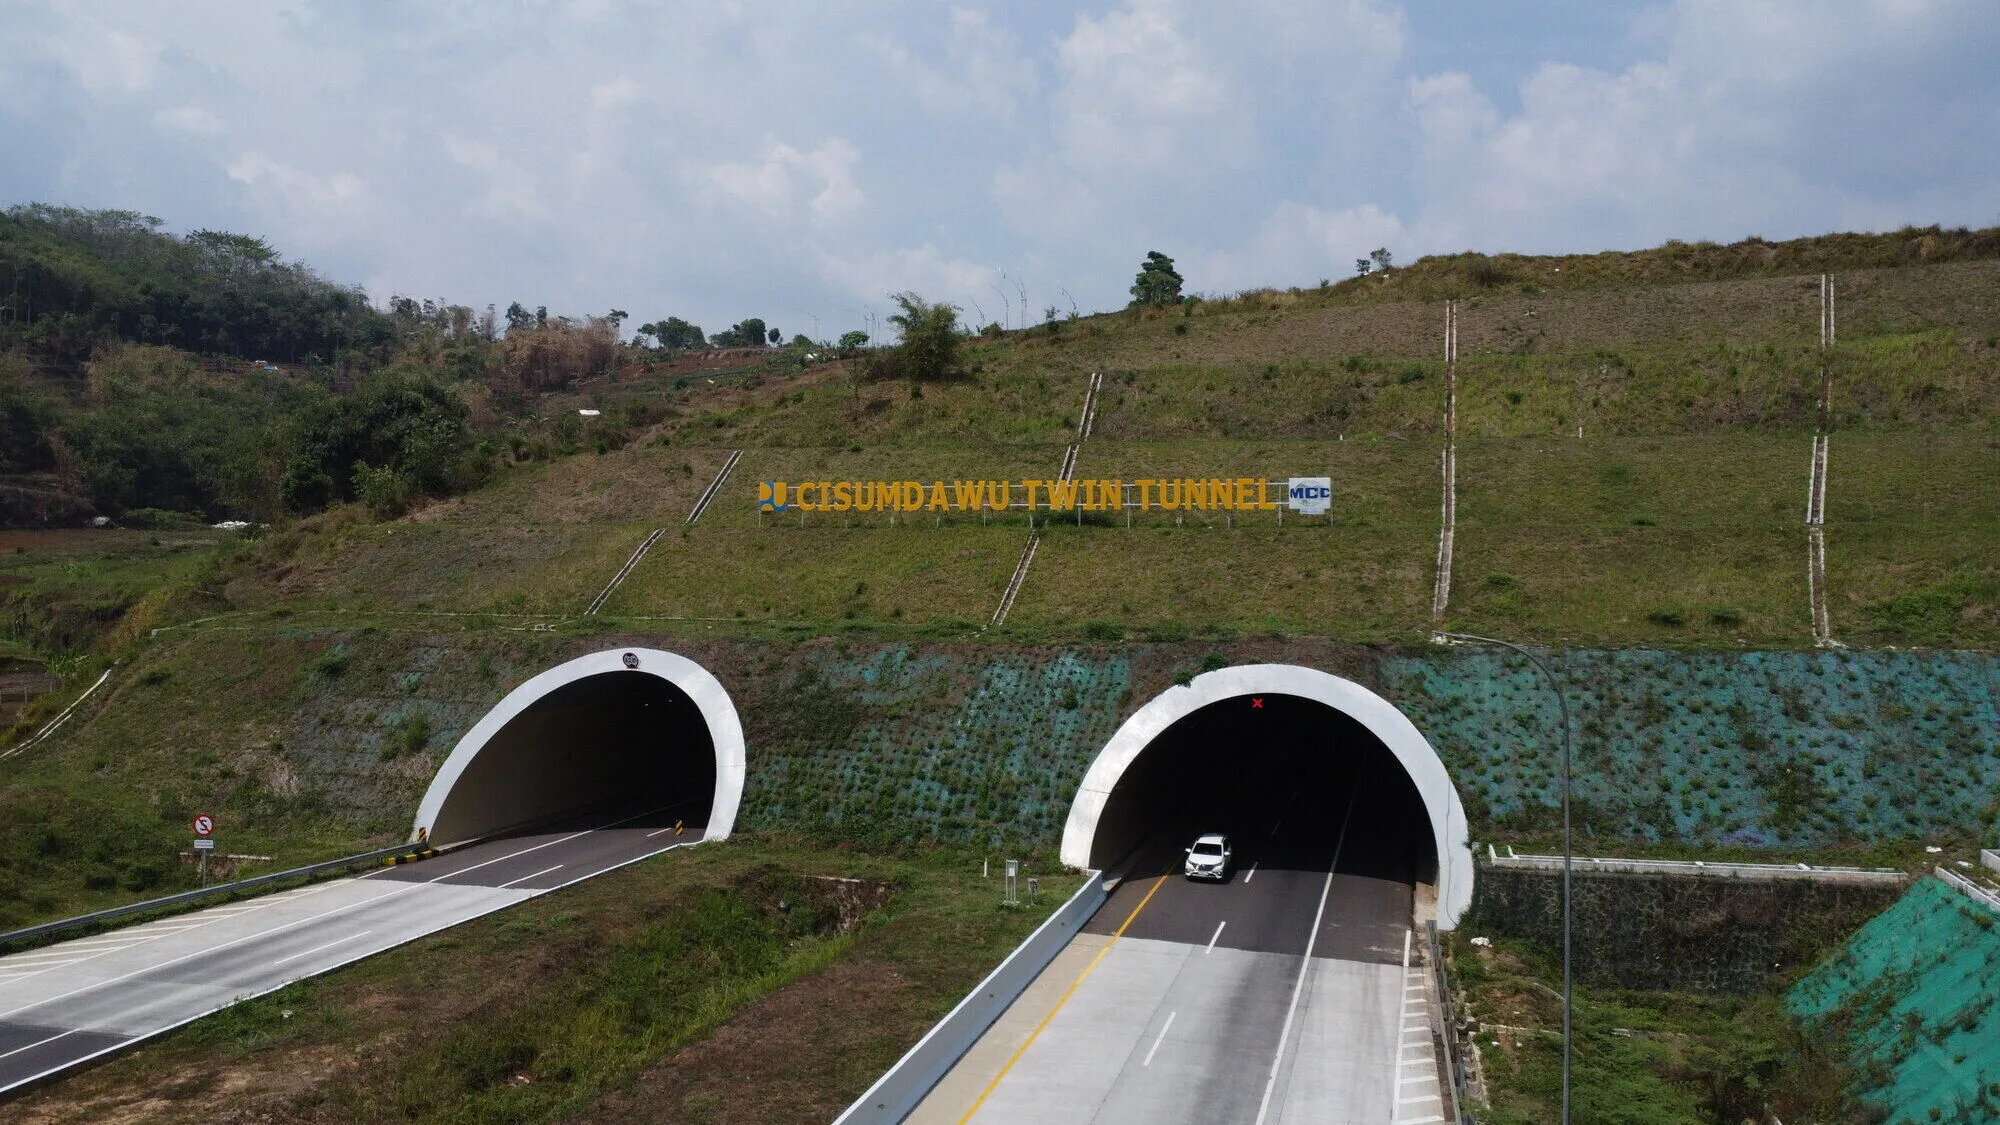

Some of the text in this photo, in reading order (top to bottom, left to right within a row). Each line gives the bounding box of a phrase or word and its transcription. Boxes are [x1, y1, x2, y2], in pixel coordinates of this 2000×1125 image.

[796, 478, 1277, 512] CISUMDAWU TWIN TUNNEL
[1290, 487, 1330, 499] MCC
